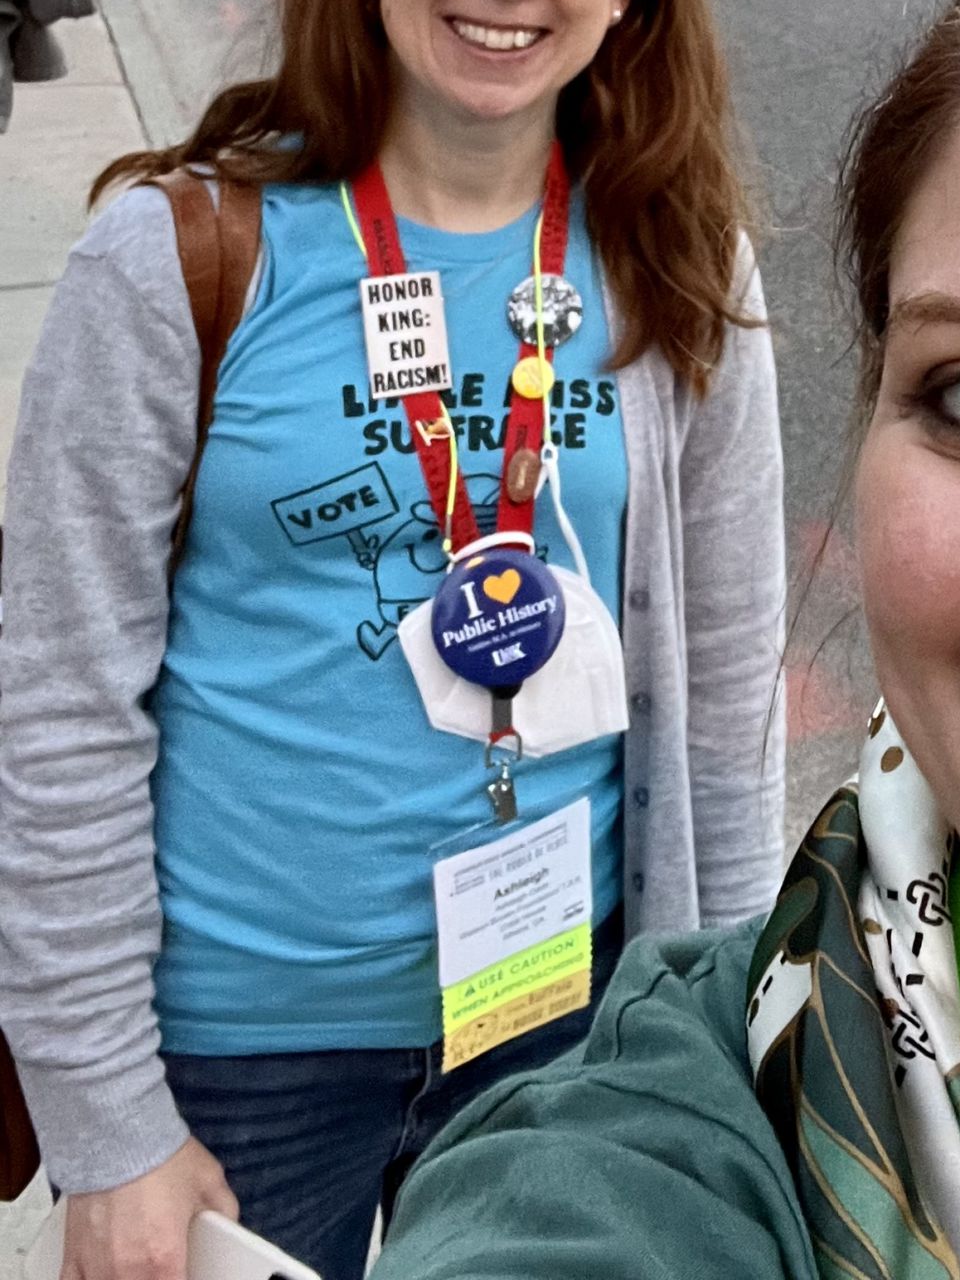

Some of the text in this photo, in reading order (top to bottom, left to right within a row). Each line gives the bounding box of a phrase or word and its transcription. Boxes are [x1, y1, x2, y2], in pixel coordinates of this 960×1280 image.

[368, 277, 433, 304] HONOR
[378, 308, 431, 332] KING:
[389, 338, 425, 361] END
[342, 373, 615, 417] LLE ISS
[373, 363, 447, 393] RACISM!
[363, 412, 586, 455] SUFRE
[287, 485, 380, 528] VOTE
[460, 581, 484, 619] I
[442, 617, 497, 648] Public
[498, 595, 557, 627] History
[479, 937, 575, 990] USE CAUTION
